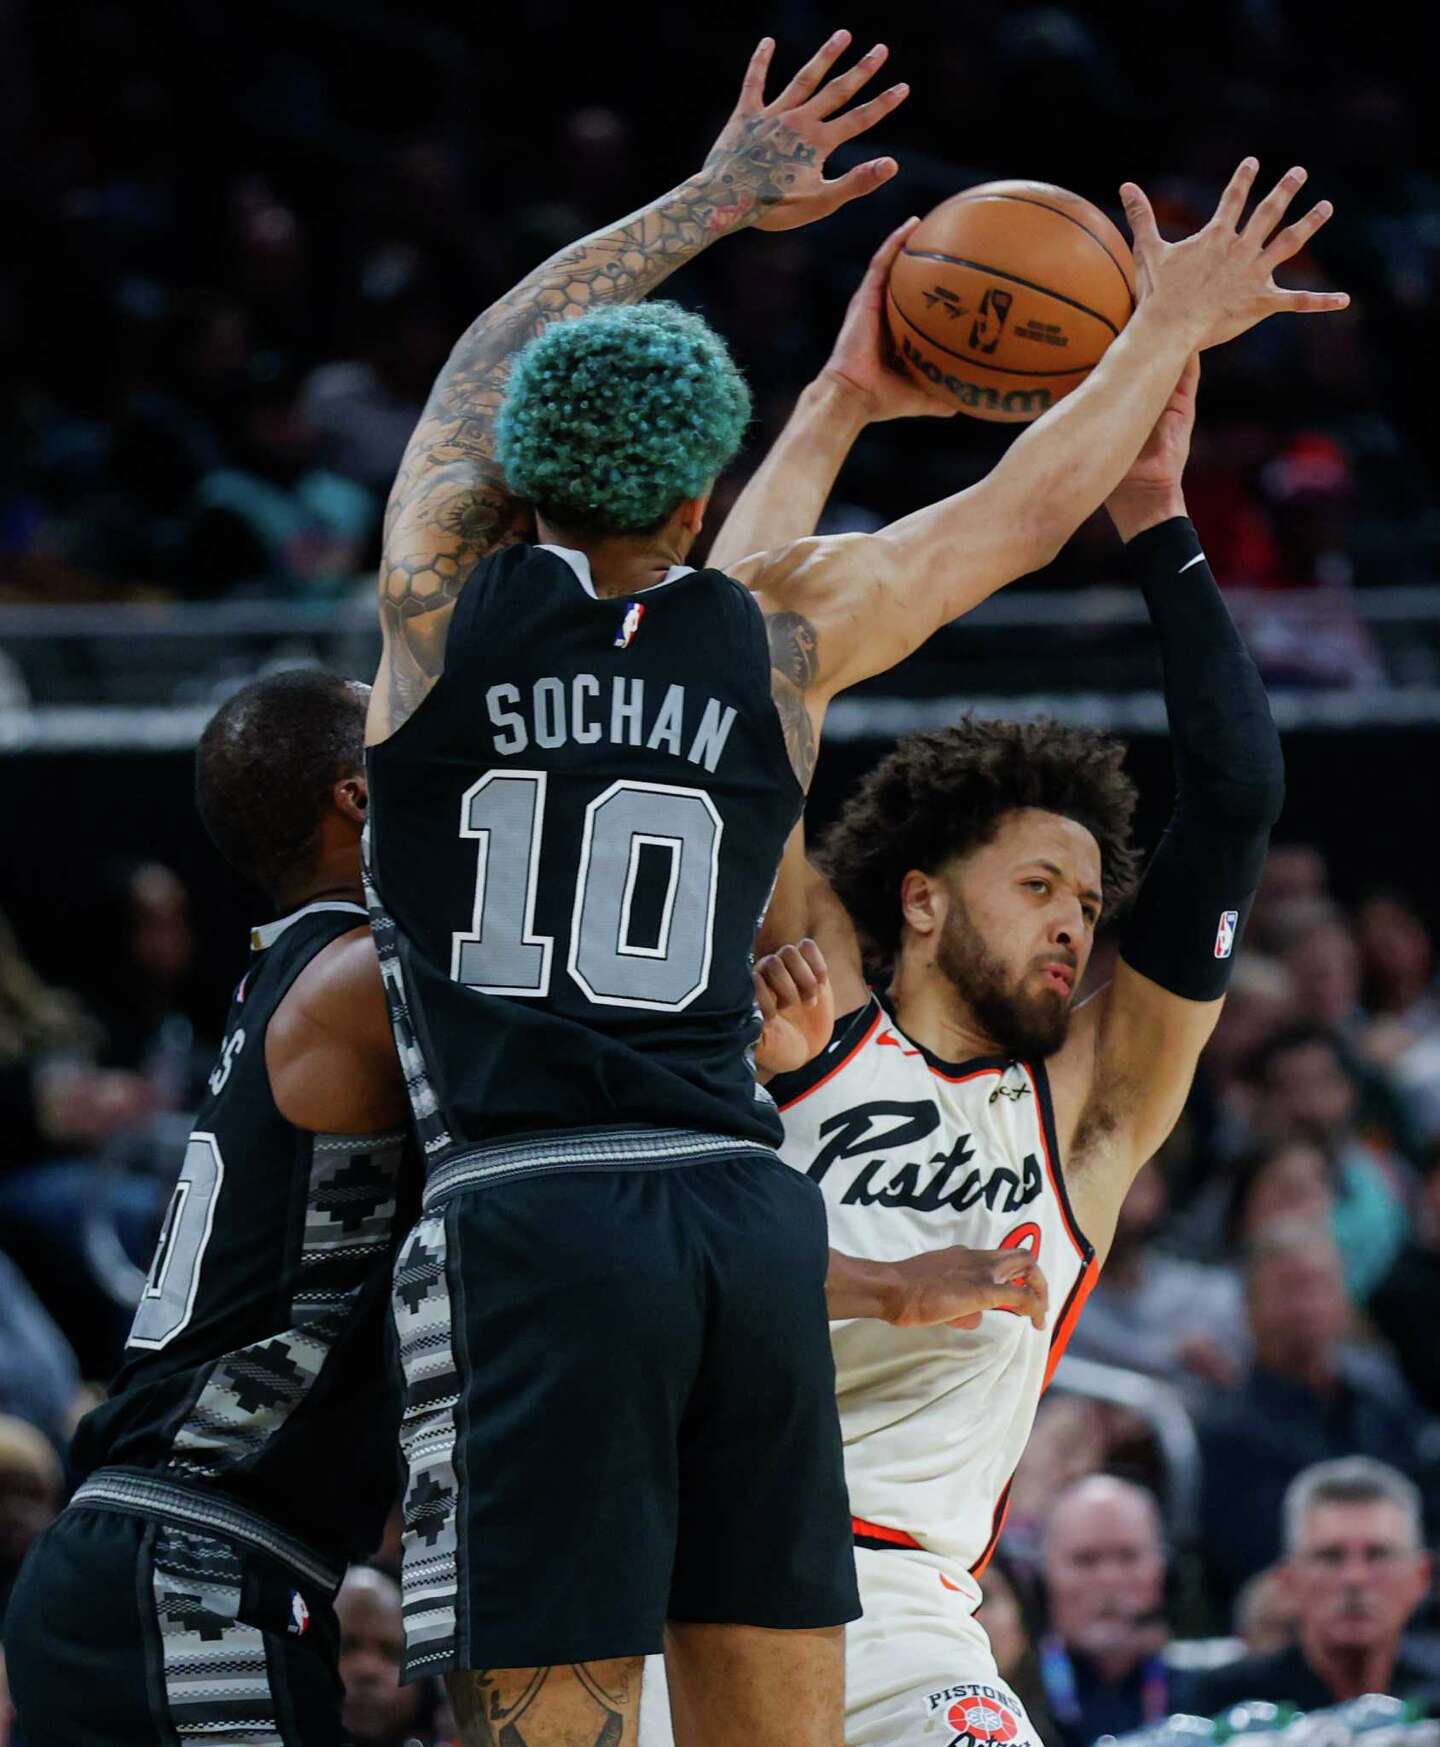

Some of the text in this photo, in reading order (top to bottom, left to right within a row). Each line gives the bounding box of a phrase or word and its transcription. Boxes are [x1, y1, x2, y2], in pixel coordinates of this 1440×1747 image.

[485, 673, 739, 774] SOCHAN
[450, 768, 725, 1013] 10
[805, 1099, 1043, 1214] Pistons
[929, 1684, 1023, 1719] PISTONS
